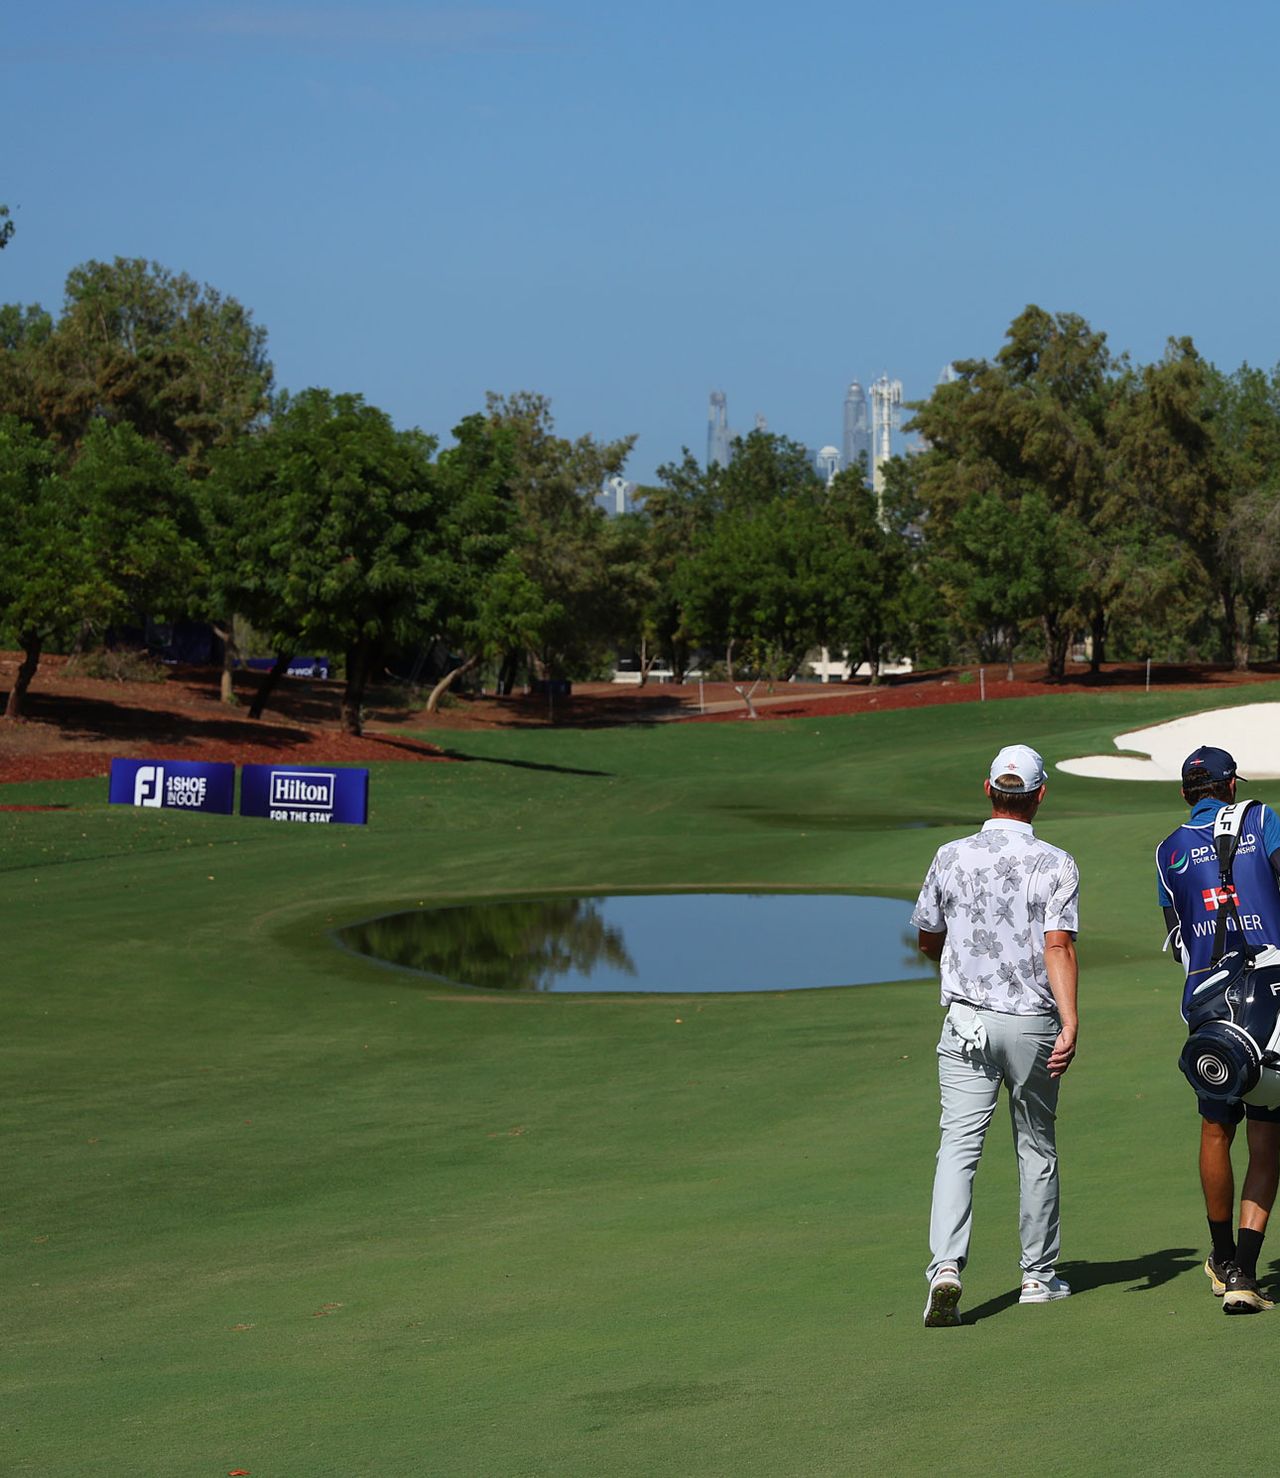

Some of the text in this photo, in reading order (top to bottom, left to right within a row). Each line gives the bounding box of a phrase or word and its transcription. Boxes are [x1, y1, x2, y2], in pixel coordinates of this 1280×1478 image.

[134, 766, 164, 808] FJ
[275, 779, 328, 802] Hilton
[177, 791, 206, 806] GOLF
[270, 810, 331, 823] FOR THE STAY
[1191, 846, 1209, 858] DP
[1193, 855, 1210, 865] TOUR
